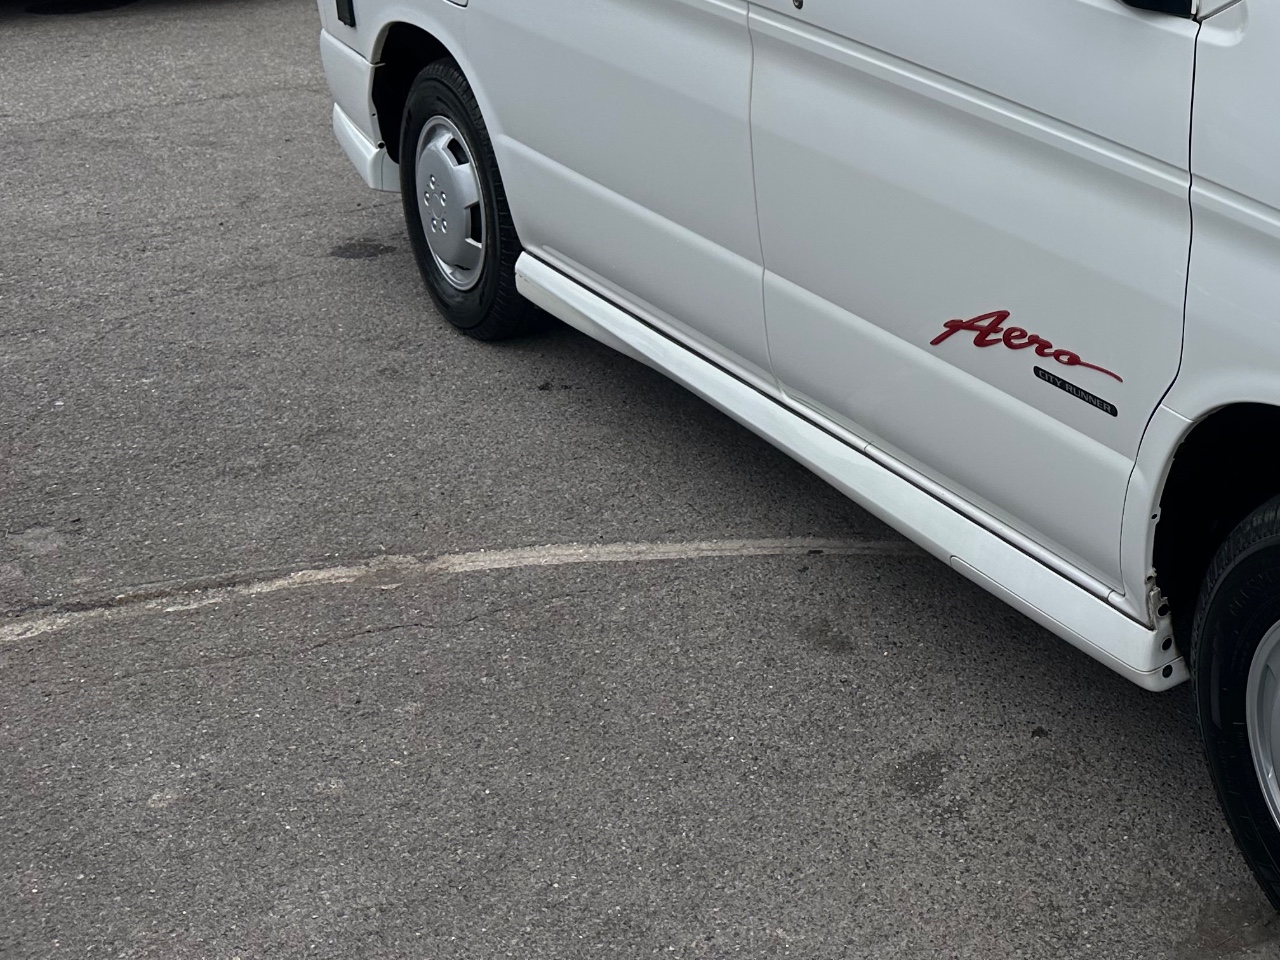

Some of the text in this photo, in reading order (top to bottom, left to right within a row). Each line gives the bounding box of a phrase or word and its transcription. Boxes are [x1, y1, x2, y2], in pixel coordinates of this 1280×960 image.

[930, 309, 1124, 383] Aero
[1039, 370, 1112, 414] CITY RUNNER
